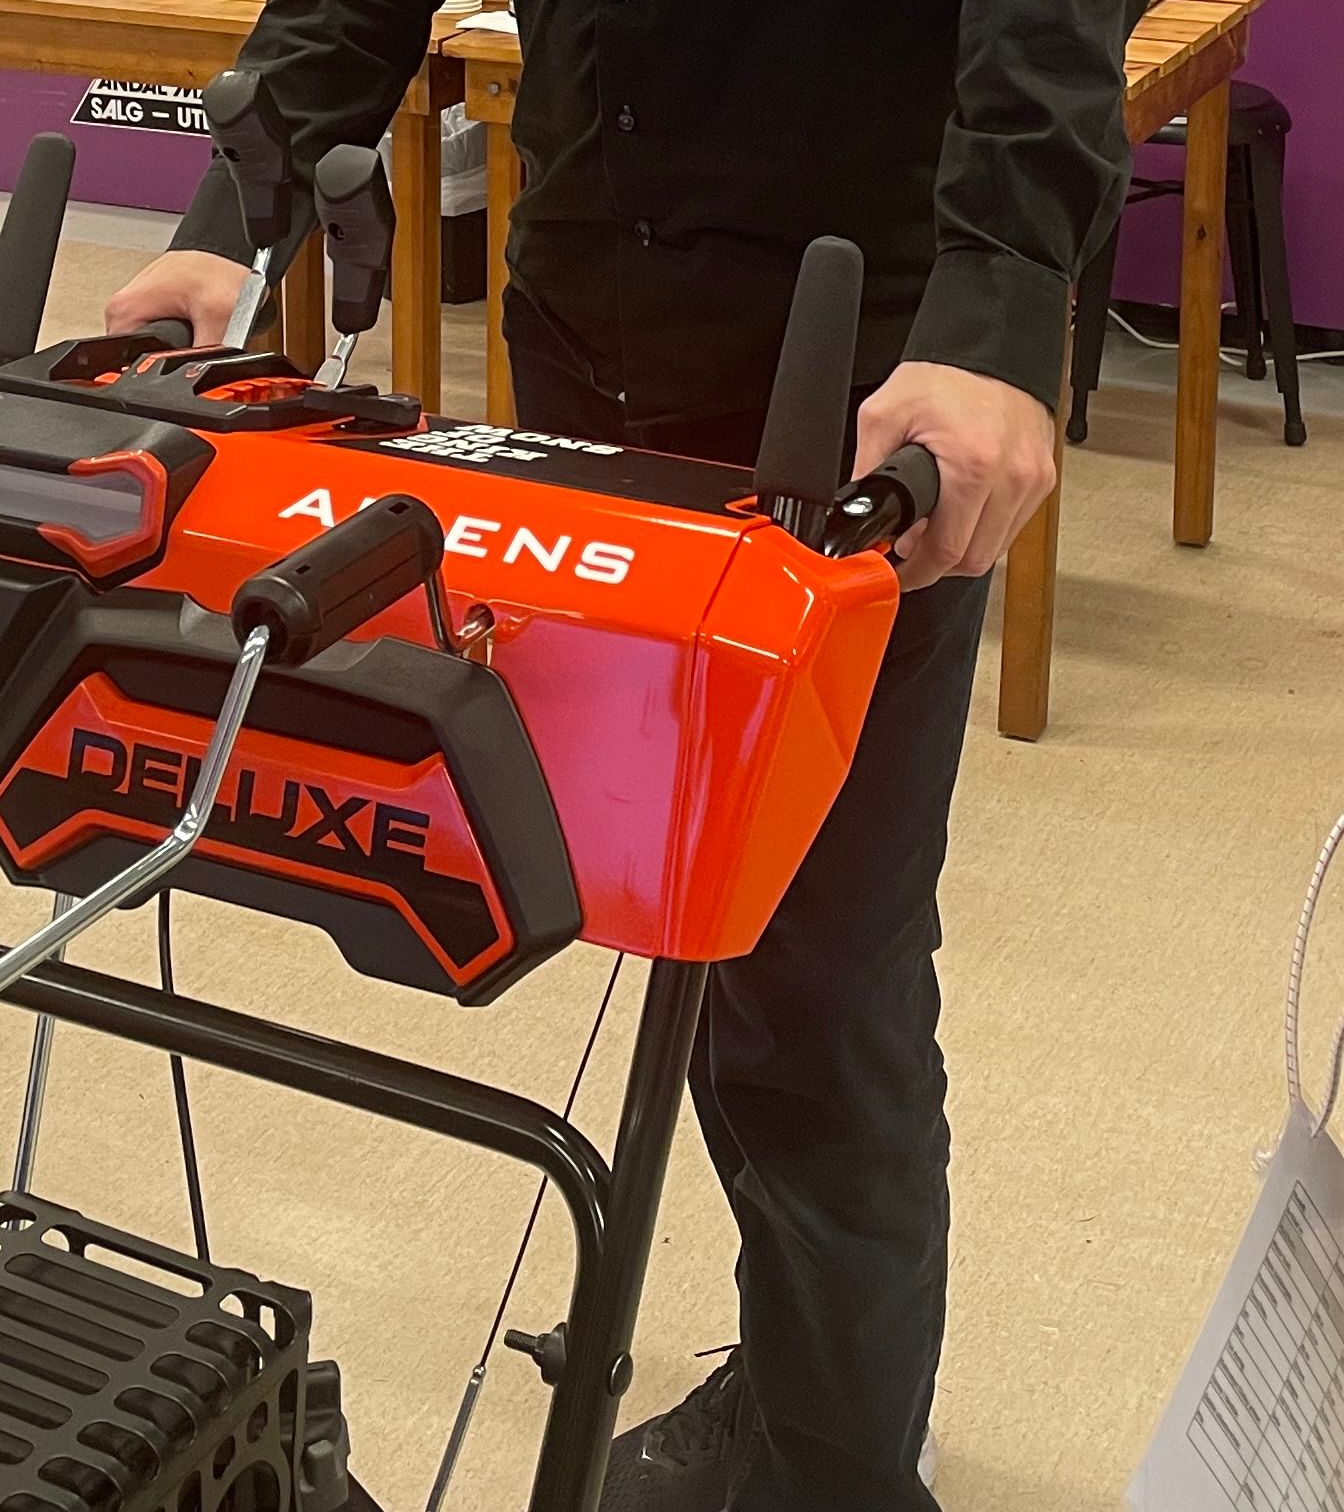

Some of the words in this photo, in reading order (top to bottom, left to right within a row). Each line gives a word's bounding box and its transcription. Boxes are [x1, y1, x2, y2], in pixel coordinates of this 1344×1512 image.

[90, 97, 144, 123] SALG
[278, 488, 635, 585] AENS
[67, 728, 430, 870] DELUXE
